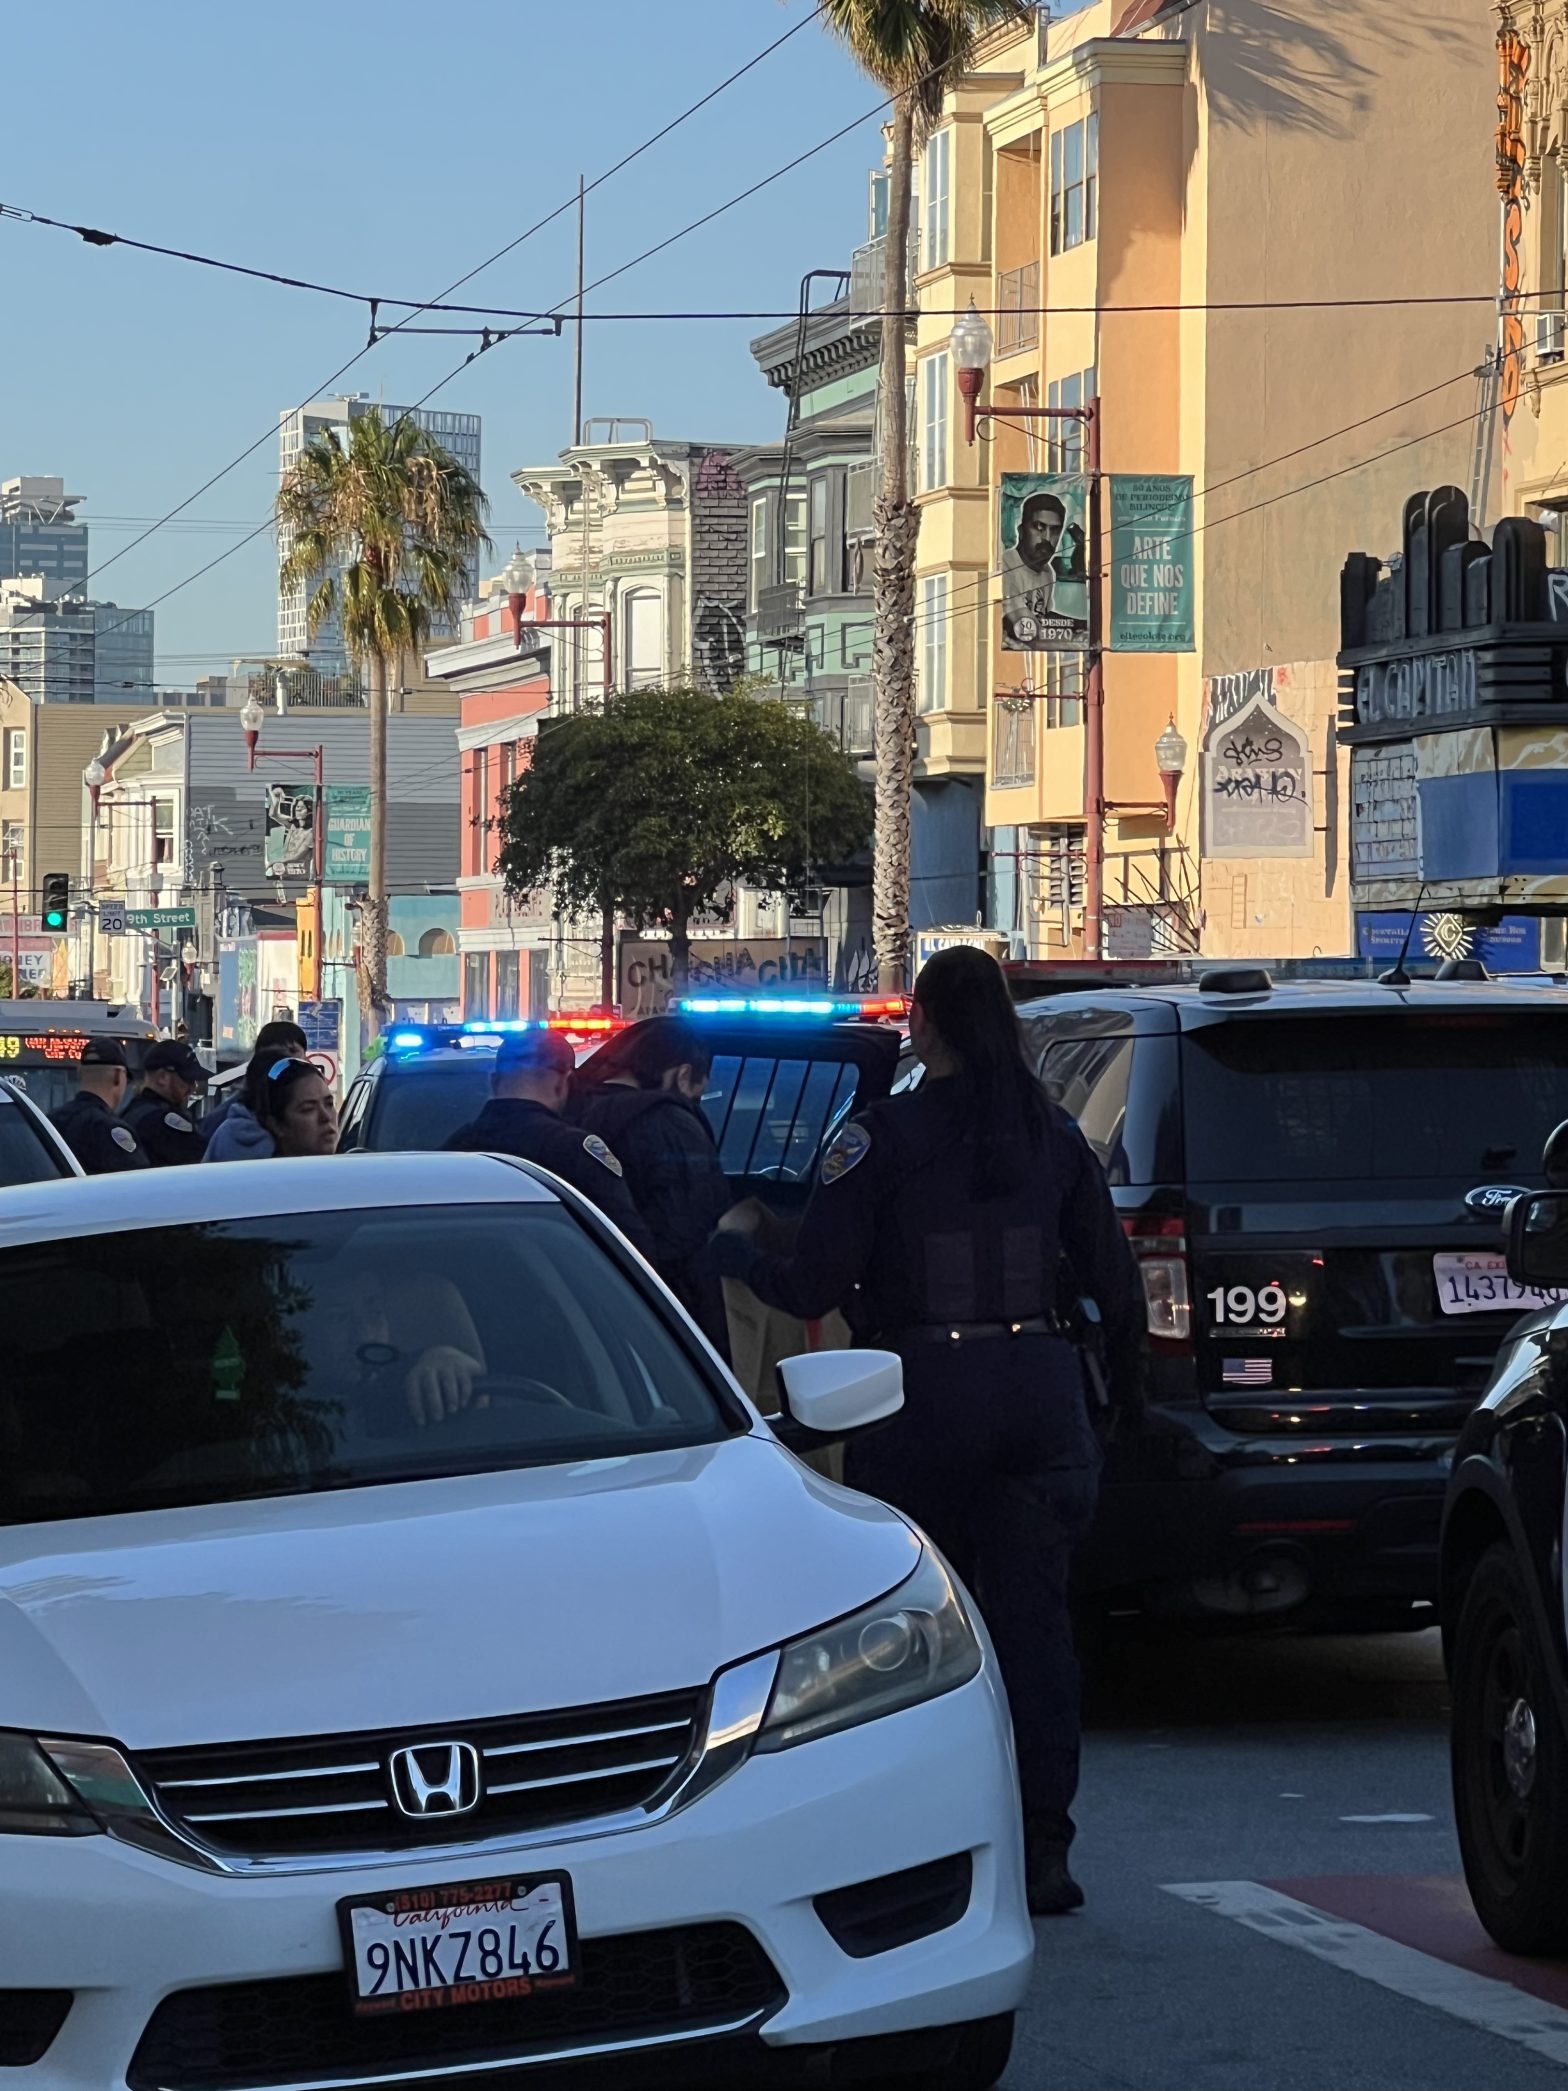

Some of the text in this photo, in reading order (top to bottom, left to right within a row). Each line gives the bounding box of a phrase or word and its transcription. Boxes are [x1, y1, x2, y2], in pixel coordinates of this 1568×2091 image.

[1132, 536, 1173, 560] ARTE
[1120, 564, 1184, 588] QUE NOS
[1127, 591, 1179, 615] DEFINE
[1041, 618, 1074, 627] DESDE
[1041, 628, 1073, 640] 1970
[1384, 648, 1477, 719] CAPITAN
[328, 817, 371, 831] GUARDIAN
[344, 832, 355, 846] OF
[331, 848, 368, 862] HISTORY
[102, 918, 122, 931] 20
[153, 913, 190, 924] Street
[1207, 1286, 1287, 1324] 199
[367, 1919, 560, 1995] 9NKZ846
[401, 1988, 447, 2011] CITY
[450, 1976, 532, 2004] MOTORS
